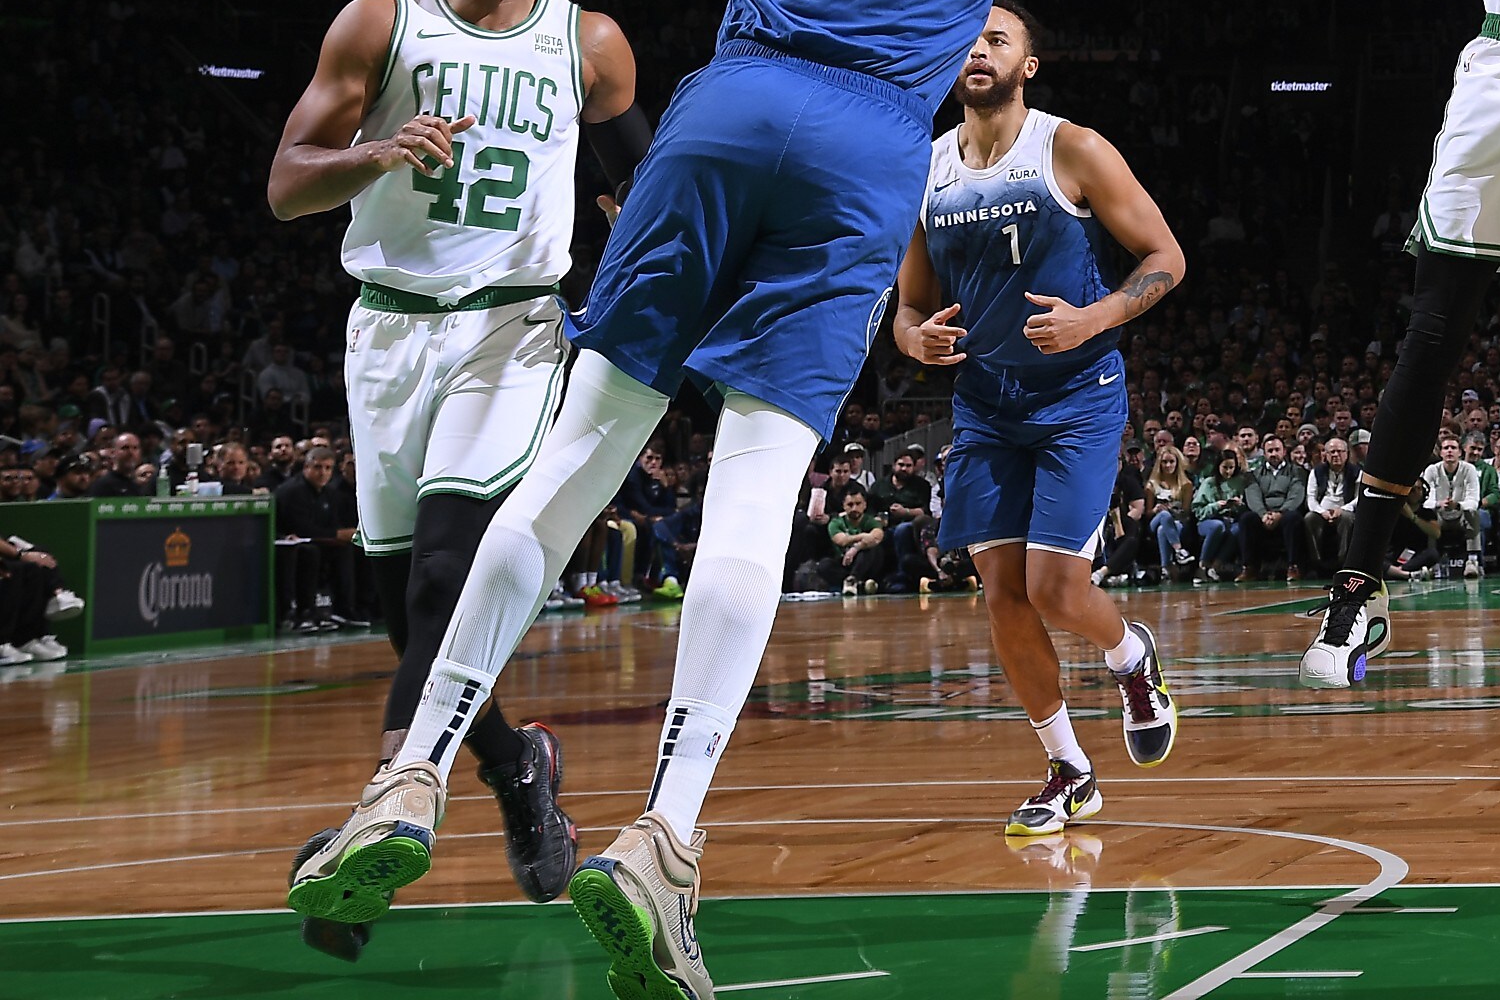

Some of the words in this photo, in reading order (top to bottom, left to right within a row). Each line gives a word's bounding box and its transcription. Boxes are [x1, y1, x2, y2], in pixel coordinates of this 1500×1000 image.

[534, 33, 564, 47] VISTA
[534, 44, 565, 56] PRINT
[1270, 80, 1329, 92] ticketmaster
[411, 61, 558, 143] CELTICS
[411, 140, 531, 232] 42
[934, 199, 1038, 229] MINNESOTA
[138, 562, 214, 628] Corona
